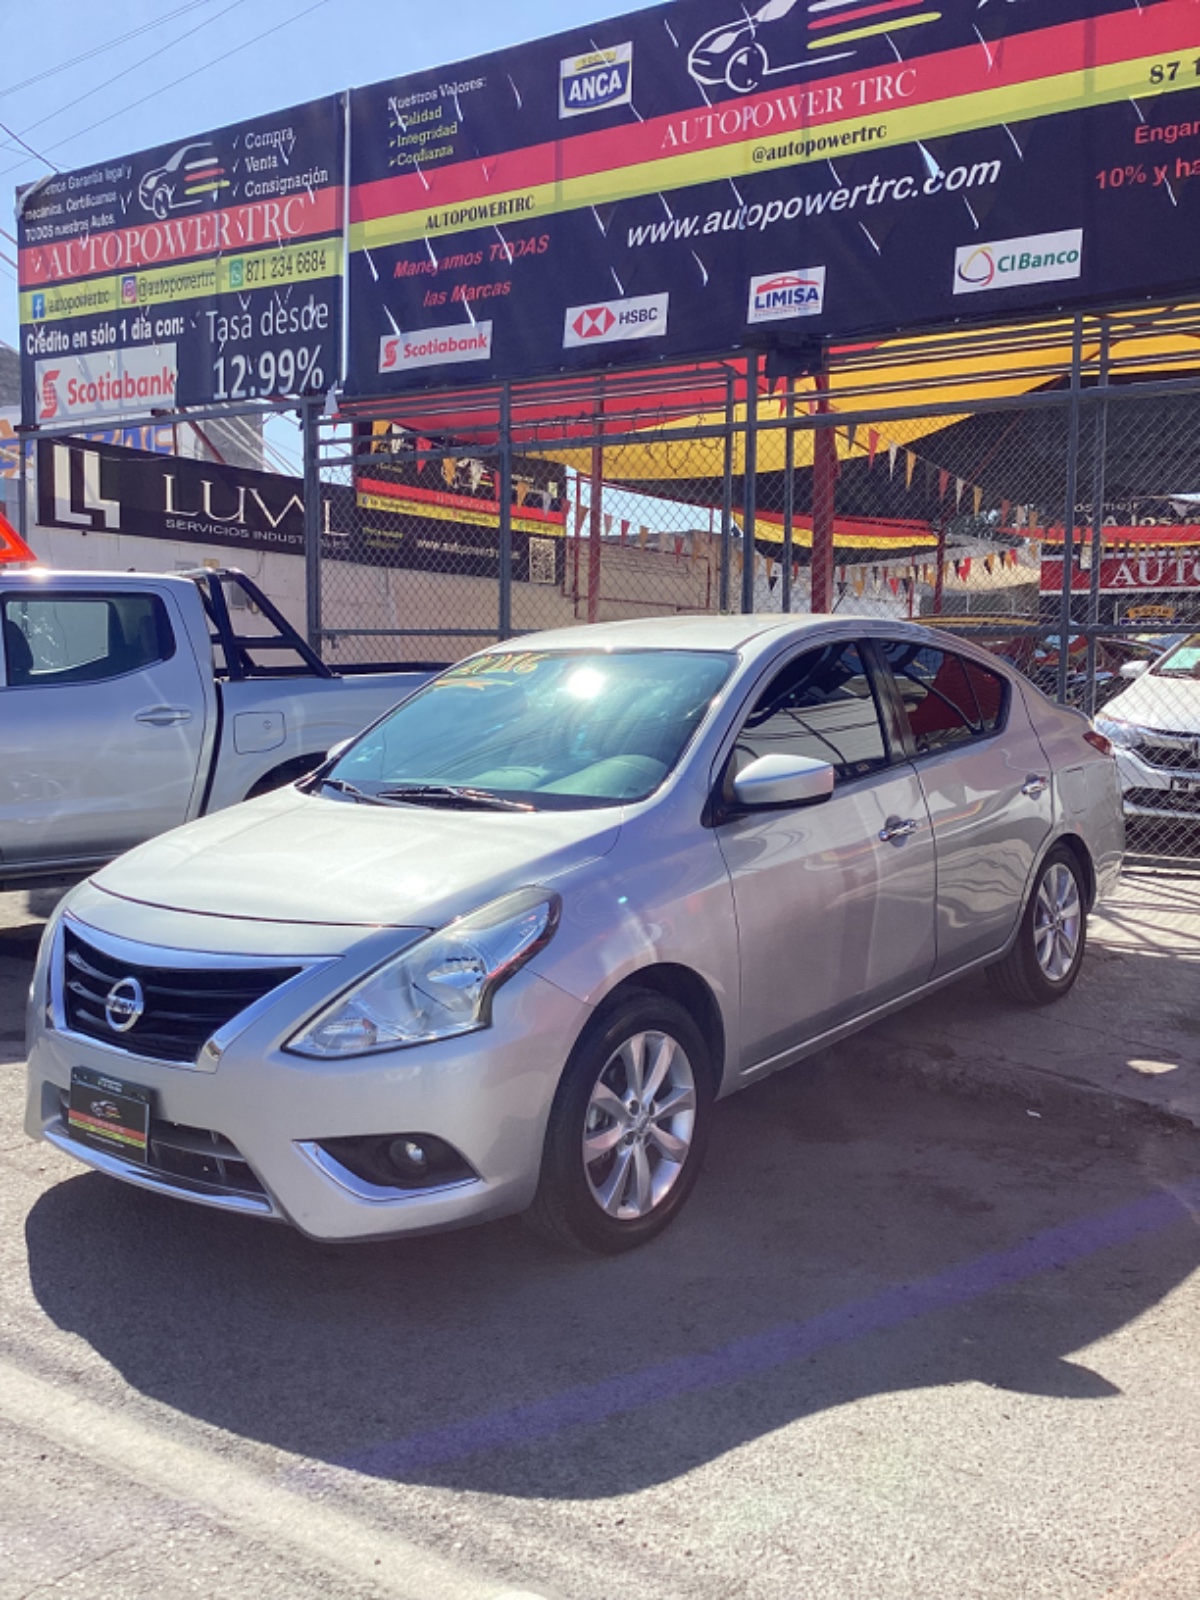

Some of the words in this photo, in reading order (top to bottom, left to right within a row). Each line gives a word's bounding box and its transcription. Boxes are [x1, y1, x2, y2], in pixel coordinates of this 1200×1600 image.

[568, 69, 622, 101] ANCA
[1149, 61, 1181, 85] 87
[388, 89, 438, 110] Nuestros
[660, 87, 845, 149] AUTOPOWER
[851, 68, 918, 108] TRC
[398, 105, 442, 126] Calidad
[245, 127, 294, 150] Compra
[397, 121, 458, 147] Integridad
[752, 124, 889, 163] @autopowertrc
[245, 156, 278, 174] Venta
[397, 145, 454, 166] Confianza
[245, 169, 328, 197] Consignación
[1096, 164, 1147, 189] 10%
[1153, 164, 1168, 187] y
[425, 194, 535, 229] AUTOPOWERTRC
[626, 159, 1001, 248] www.autopowertrc.com
[25, 225, 54, 242] TODOS
[55, 220, 89, 236] nuestros
[46, 213, 231, 279] AUTOPOWER
[239, 197, 305, 241] TRC
[245, 258, 267, 283] 871
[270, 253, 294, 279] 234
[297, 249, 327, 274] 6684
[138, 270, 216, 303] @autopowertrc
[423, 290, 448, 308] las
[451, 280, 512, 303] Marcas
[755, 287, 819, 309] LIMISA
[206, 308, 252, 344] Tasa
[260, 294, 329, 336] desde
[618, 306, 659, 326] HSBC
[26, 327, 70, 355] Crédito
[72, 332, 87, 348] en
[90, 322, 116, 346] sólo
[119, 319, 127, 341] 1
[403, 332, 488, 359] Scotiabank
[67, 366, 176, 405] Scotiabank
[212, 345, 324, 400] 12.99%
[166, 519, 249, 539] SERVICIOS
